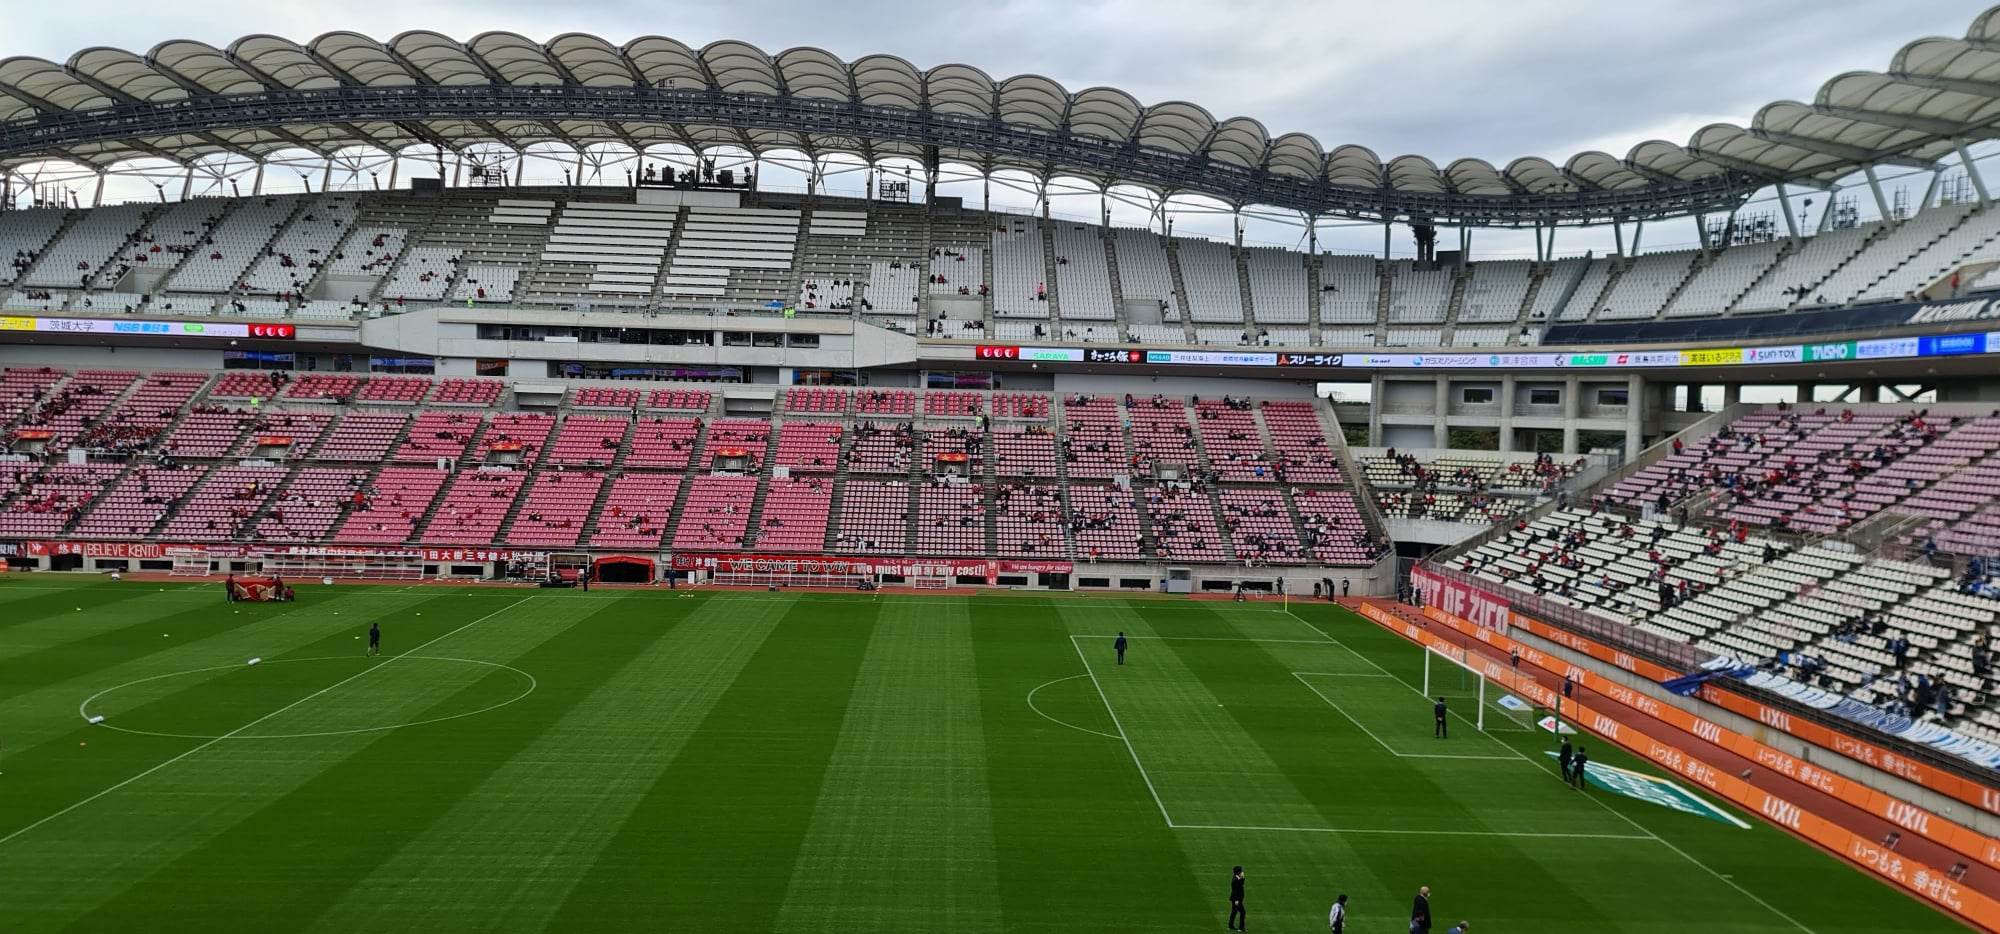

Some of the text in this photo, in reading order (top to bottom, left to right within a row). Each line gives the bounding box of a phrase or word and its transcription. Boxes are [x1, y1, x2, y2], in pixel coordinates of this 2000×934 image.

[49, 319, 94, 332] 茨城大学
[1289, 355, 1343, 366] スリーライク
[87, 543, 126, 557] BELIEVE
[875, 565, 902, 576] must
[1443, 585, 1466, 617] OF
[1468, 595, 1509, 637] ZICO
[1614, 652, 1637, 671] LIXIL
[1593, 714, 1619, 740] LIXIL
[1692, 718, 1721, 744] LIXIL
[1760, 707, 1792, 732] LIXIL
[1762, 795, 1801, 830] LIXIL
[1887, 800, 1928, 834] LIXIL
[1854, 841, 1962, 911] いつもを、幸せに。
